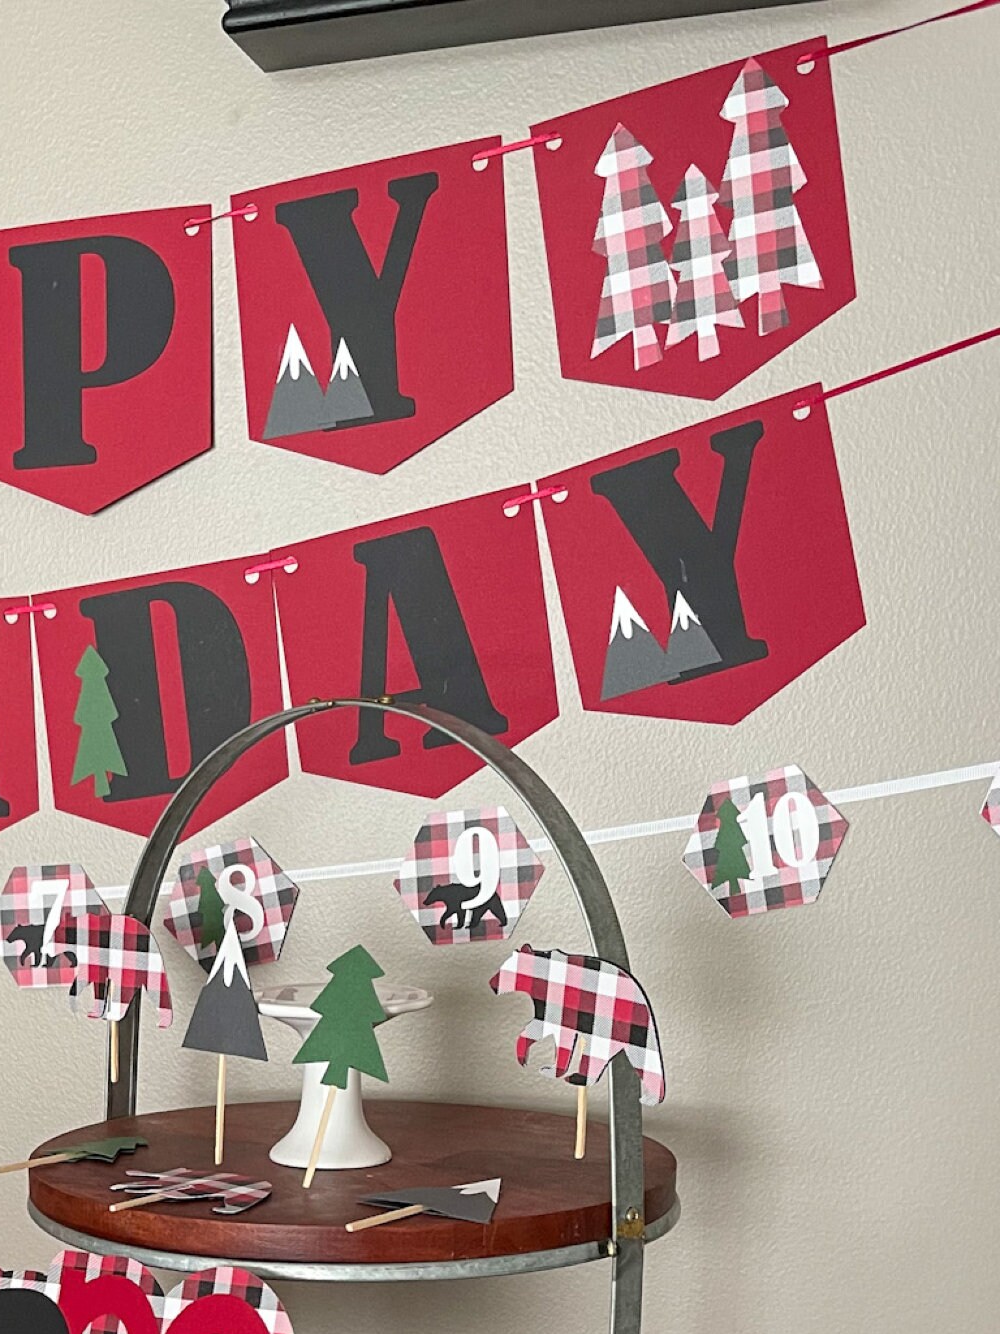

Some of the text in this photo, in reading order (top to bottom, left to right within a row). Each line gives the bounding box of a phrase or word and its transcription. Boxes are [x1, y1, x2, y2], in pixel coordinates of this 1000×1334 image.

[30, 878, 70, 958] 7
[217, 863, 265, 942] 8
[453, 826, 501, 911] 9
[736, 791, 820, 881] 10
